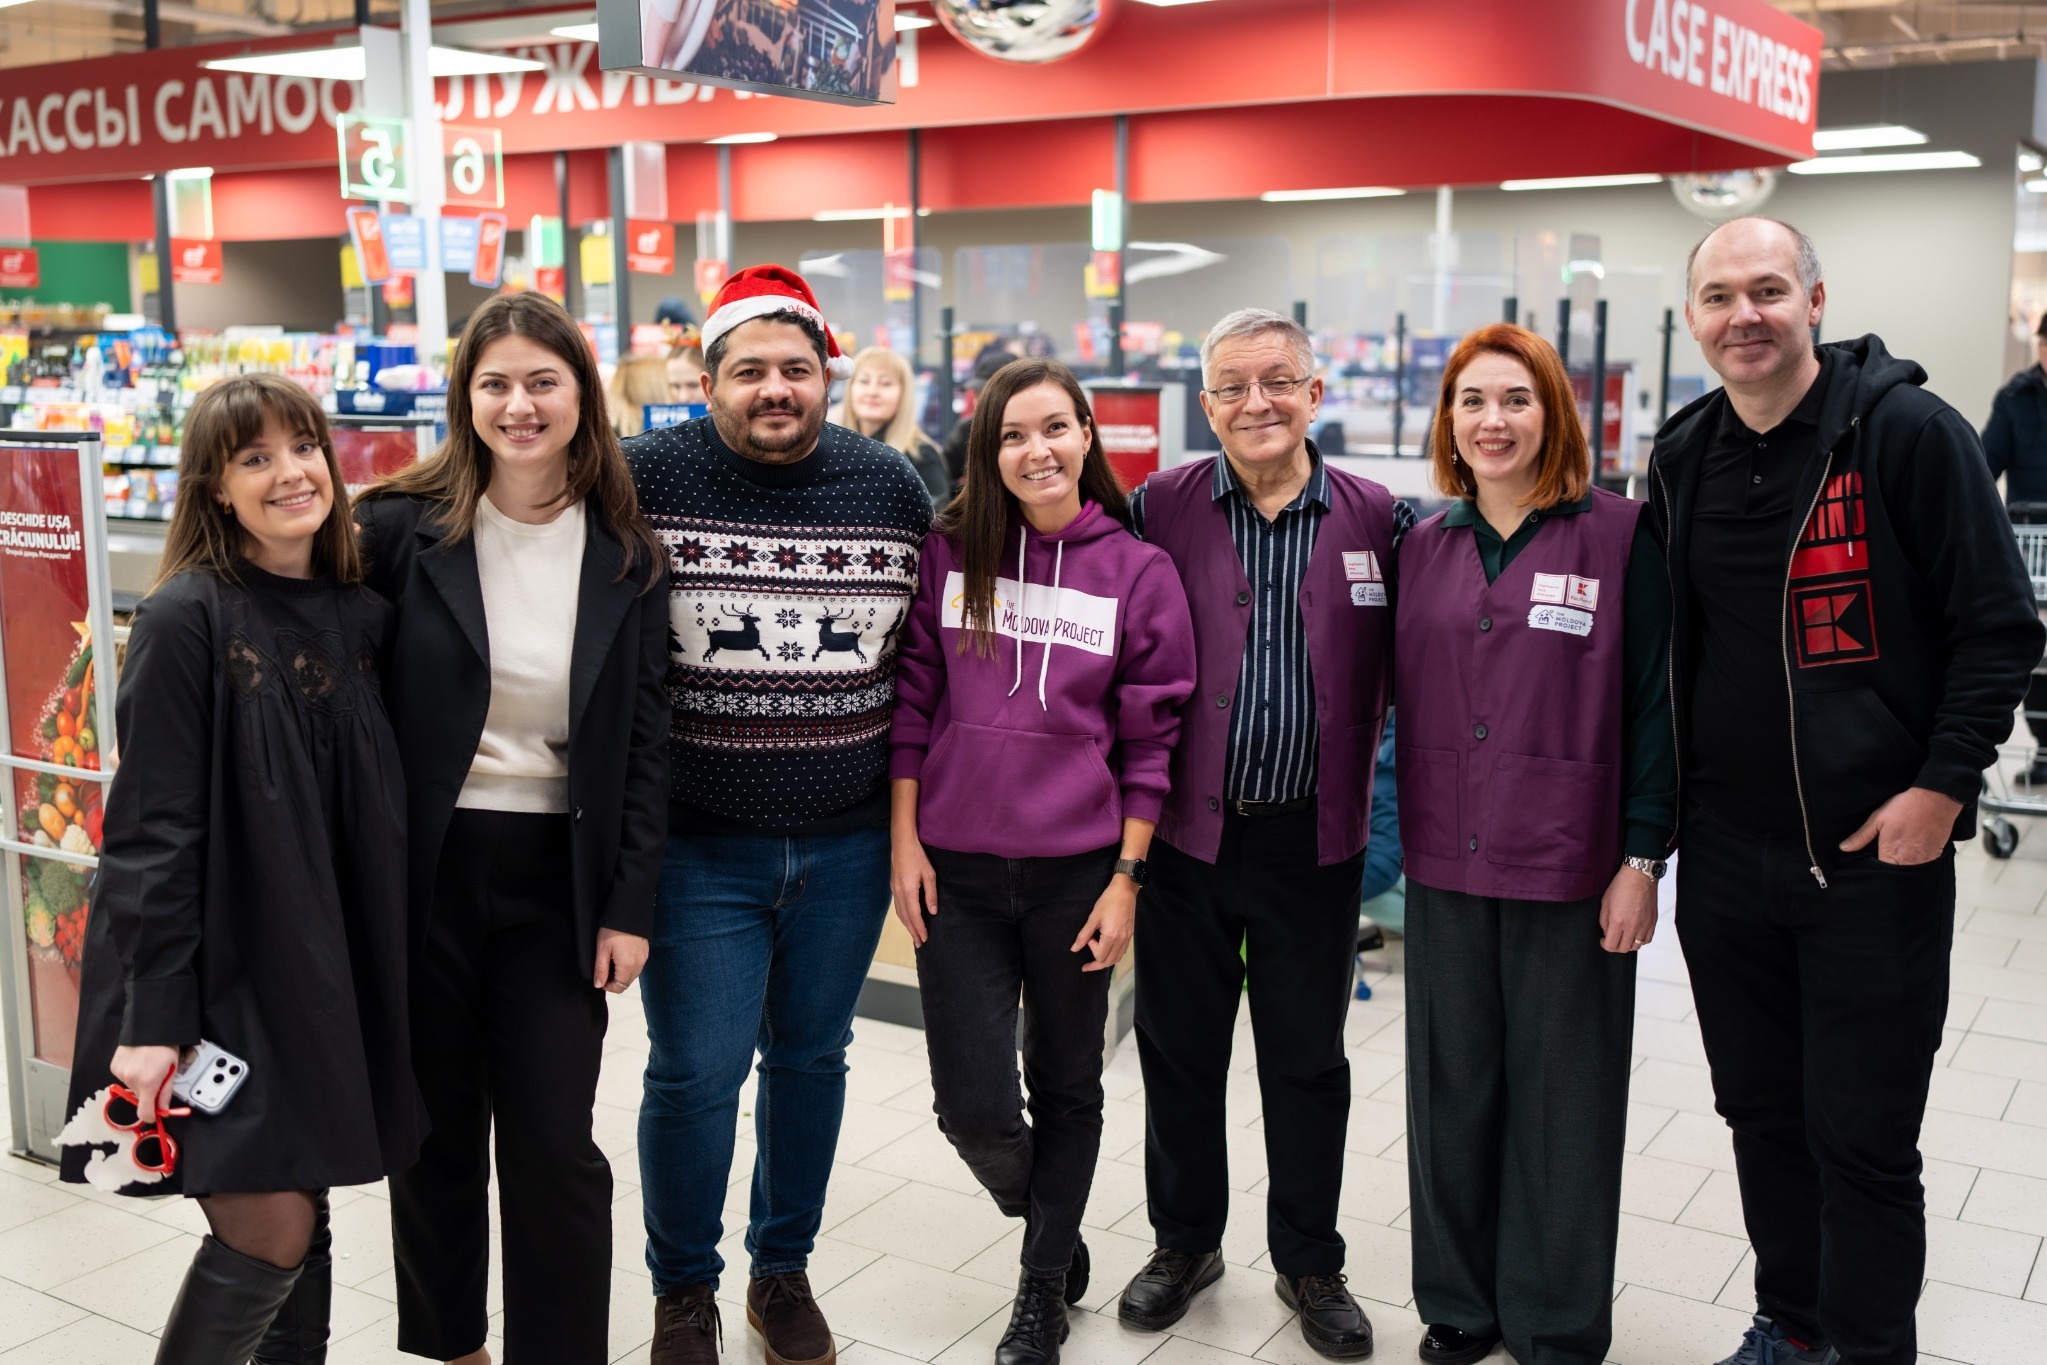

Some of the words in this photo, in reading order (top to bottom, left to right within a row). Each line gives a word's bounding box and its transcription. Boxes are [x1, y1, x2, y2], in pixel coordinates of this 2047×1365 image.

[1625, 0, 1706, 87] CASE
[1710, 14, 1812, 124] EXPRESS
[0, 511, 45, 528] DESCHIDE
[1006, 599, 1015, 610] THE
[1554, 622, 1582, 631] PROJECT
[1555, 617, 1587, 627] MOLDOVA
[1053, 617, 1105, 647] PROJECT
